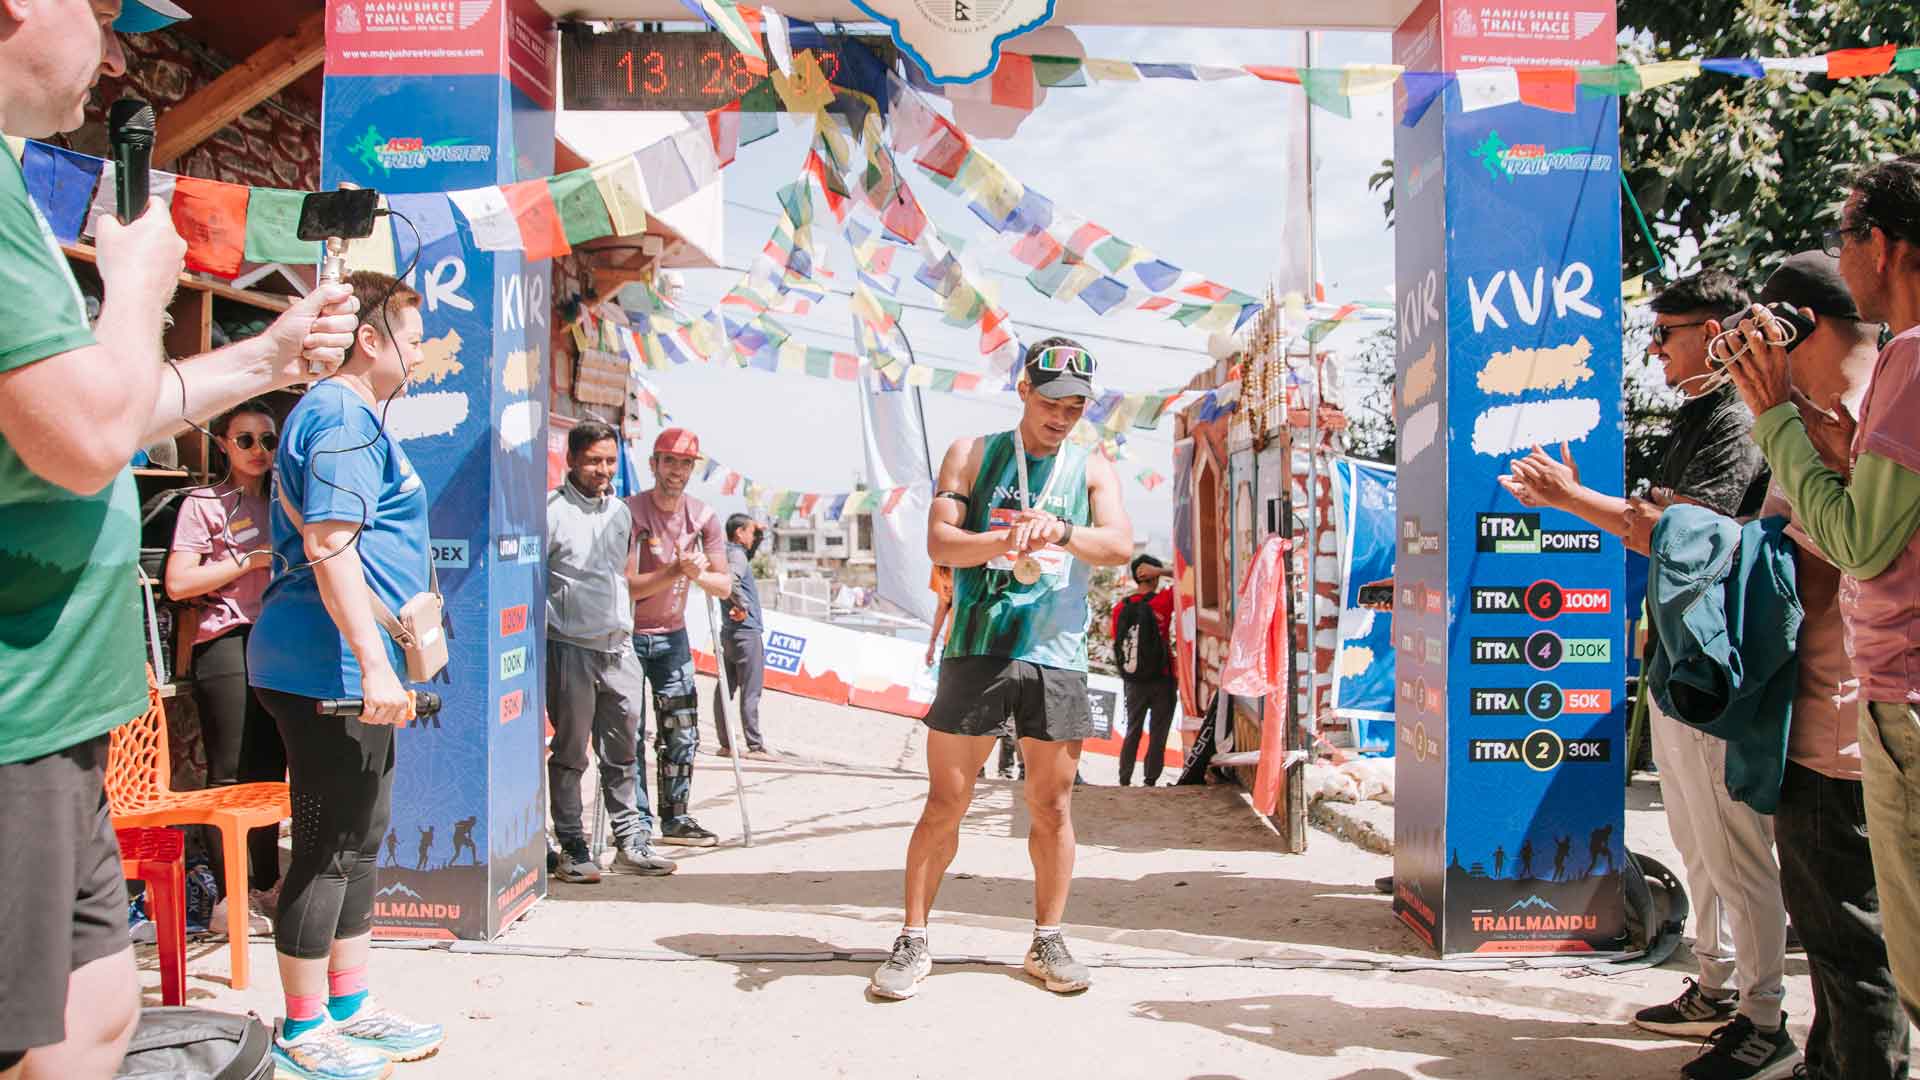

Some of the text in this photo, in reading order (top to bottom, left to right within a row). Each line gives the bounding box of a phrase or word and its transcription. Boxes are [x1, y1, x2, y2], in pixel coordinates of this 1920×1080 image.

[364, 12, 455, 25] TRAIL RACE
[1480, 18, 1569, 33] TRAIL RACE
[501, 273, 545, 332] KVR
[1467, 261, 1603, 334] KVR
[1400, 268, 1440, 353] KVR
[1480, 516, 1600, 550] iTRA POINTS
[431, 546, 464, 562] DEX
[1476, 590, 1607, 609] iTRA 6 100M
[771, 633, 803, 652] KTM
[1476, 641, 1607, 660] iTRA 4 100K
[766, 653, 796, 669] CTY
[1475, 692, 1601, 711] iTRA 3 50K
[1475, 740, 1601, 760] iTRA 2 30K
[373, 902, 461, 920] ILMANDU
[1471, 914, 1598, 932] TRAILMANDU
